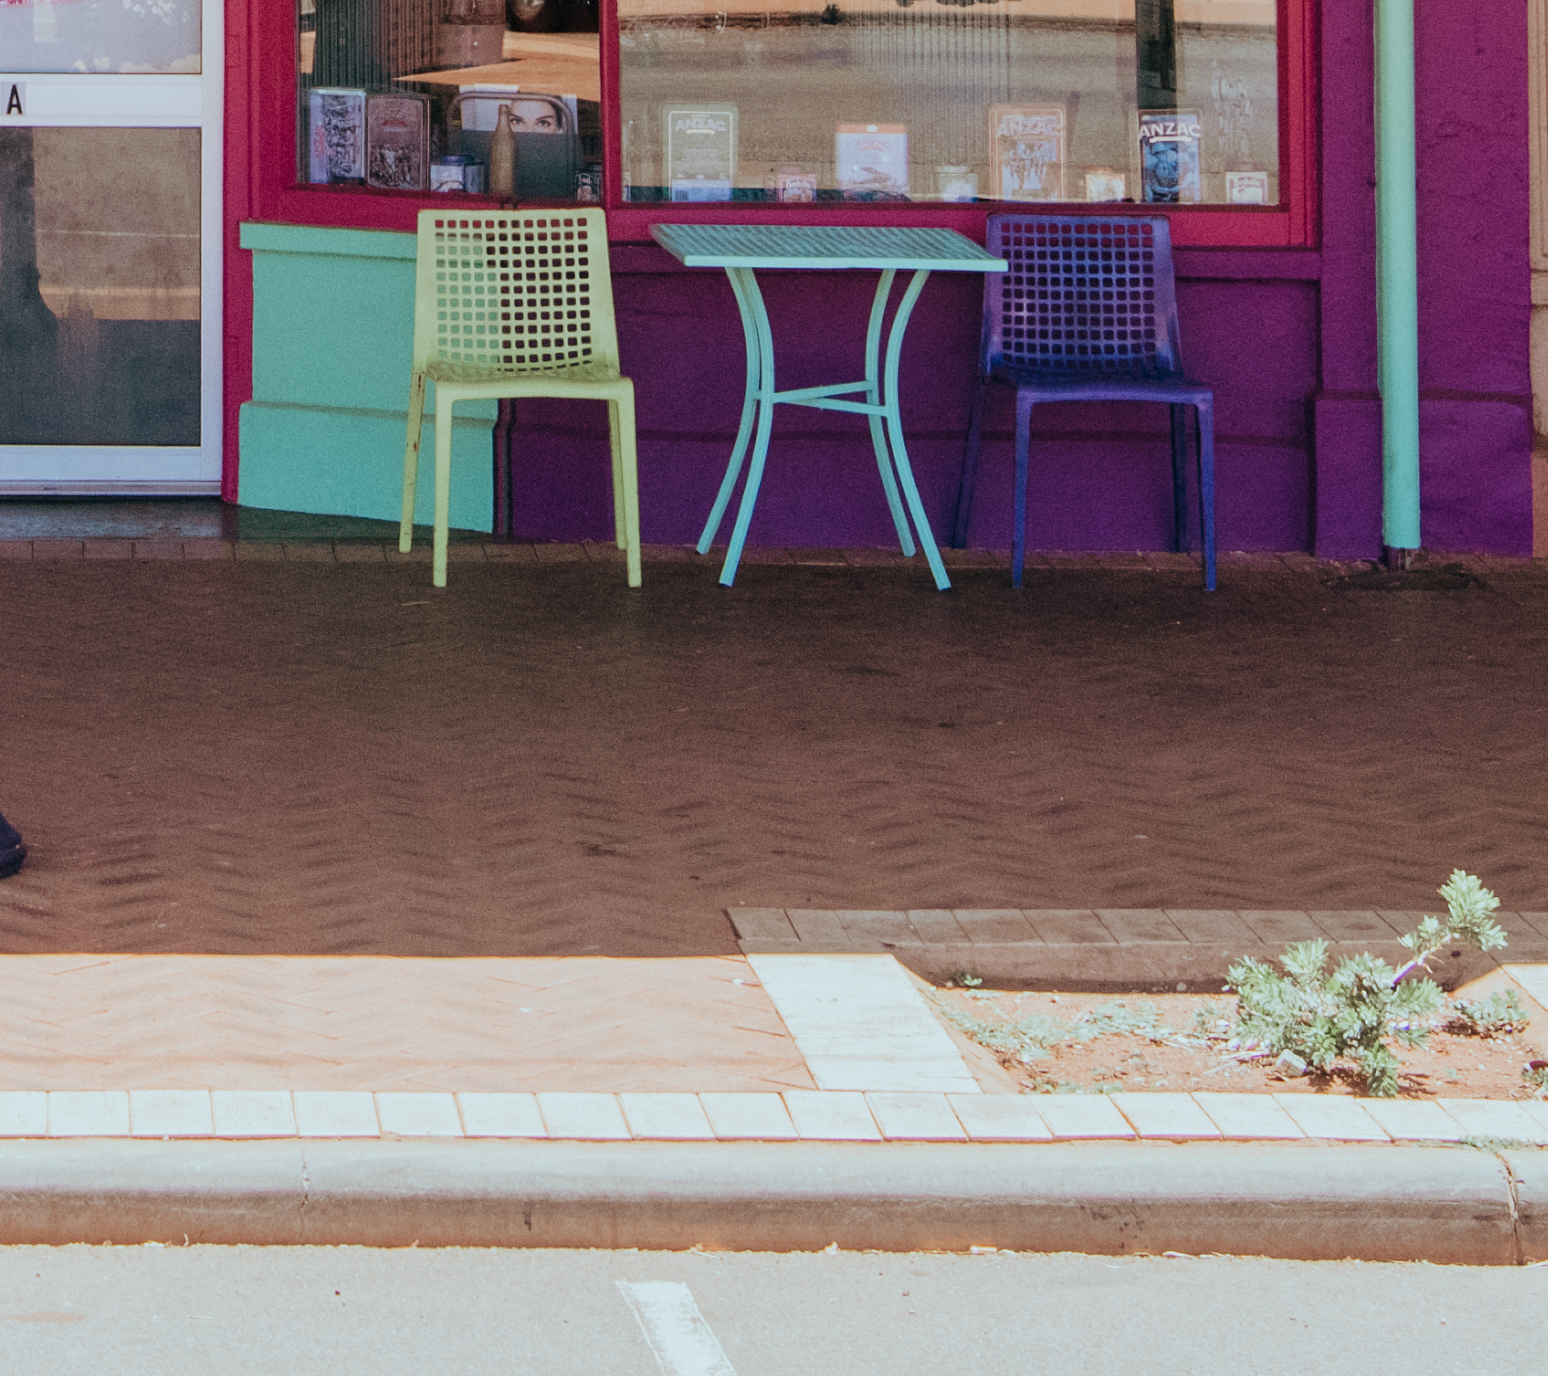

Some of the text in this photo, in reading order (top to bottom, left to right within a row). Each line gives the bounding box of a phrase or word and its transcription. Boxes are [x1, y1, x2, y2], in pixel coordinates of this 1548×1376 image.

[674, 117, 727, 133] ANZAC
[995, 121, 1062, 139] ANZAC
[1138, 122, 1202, 138] ANZAC
